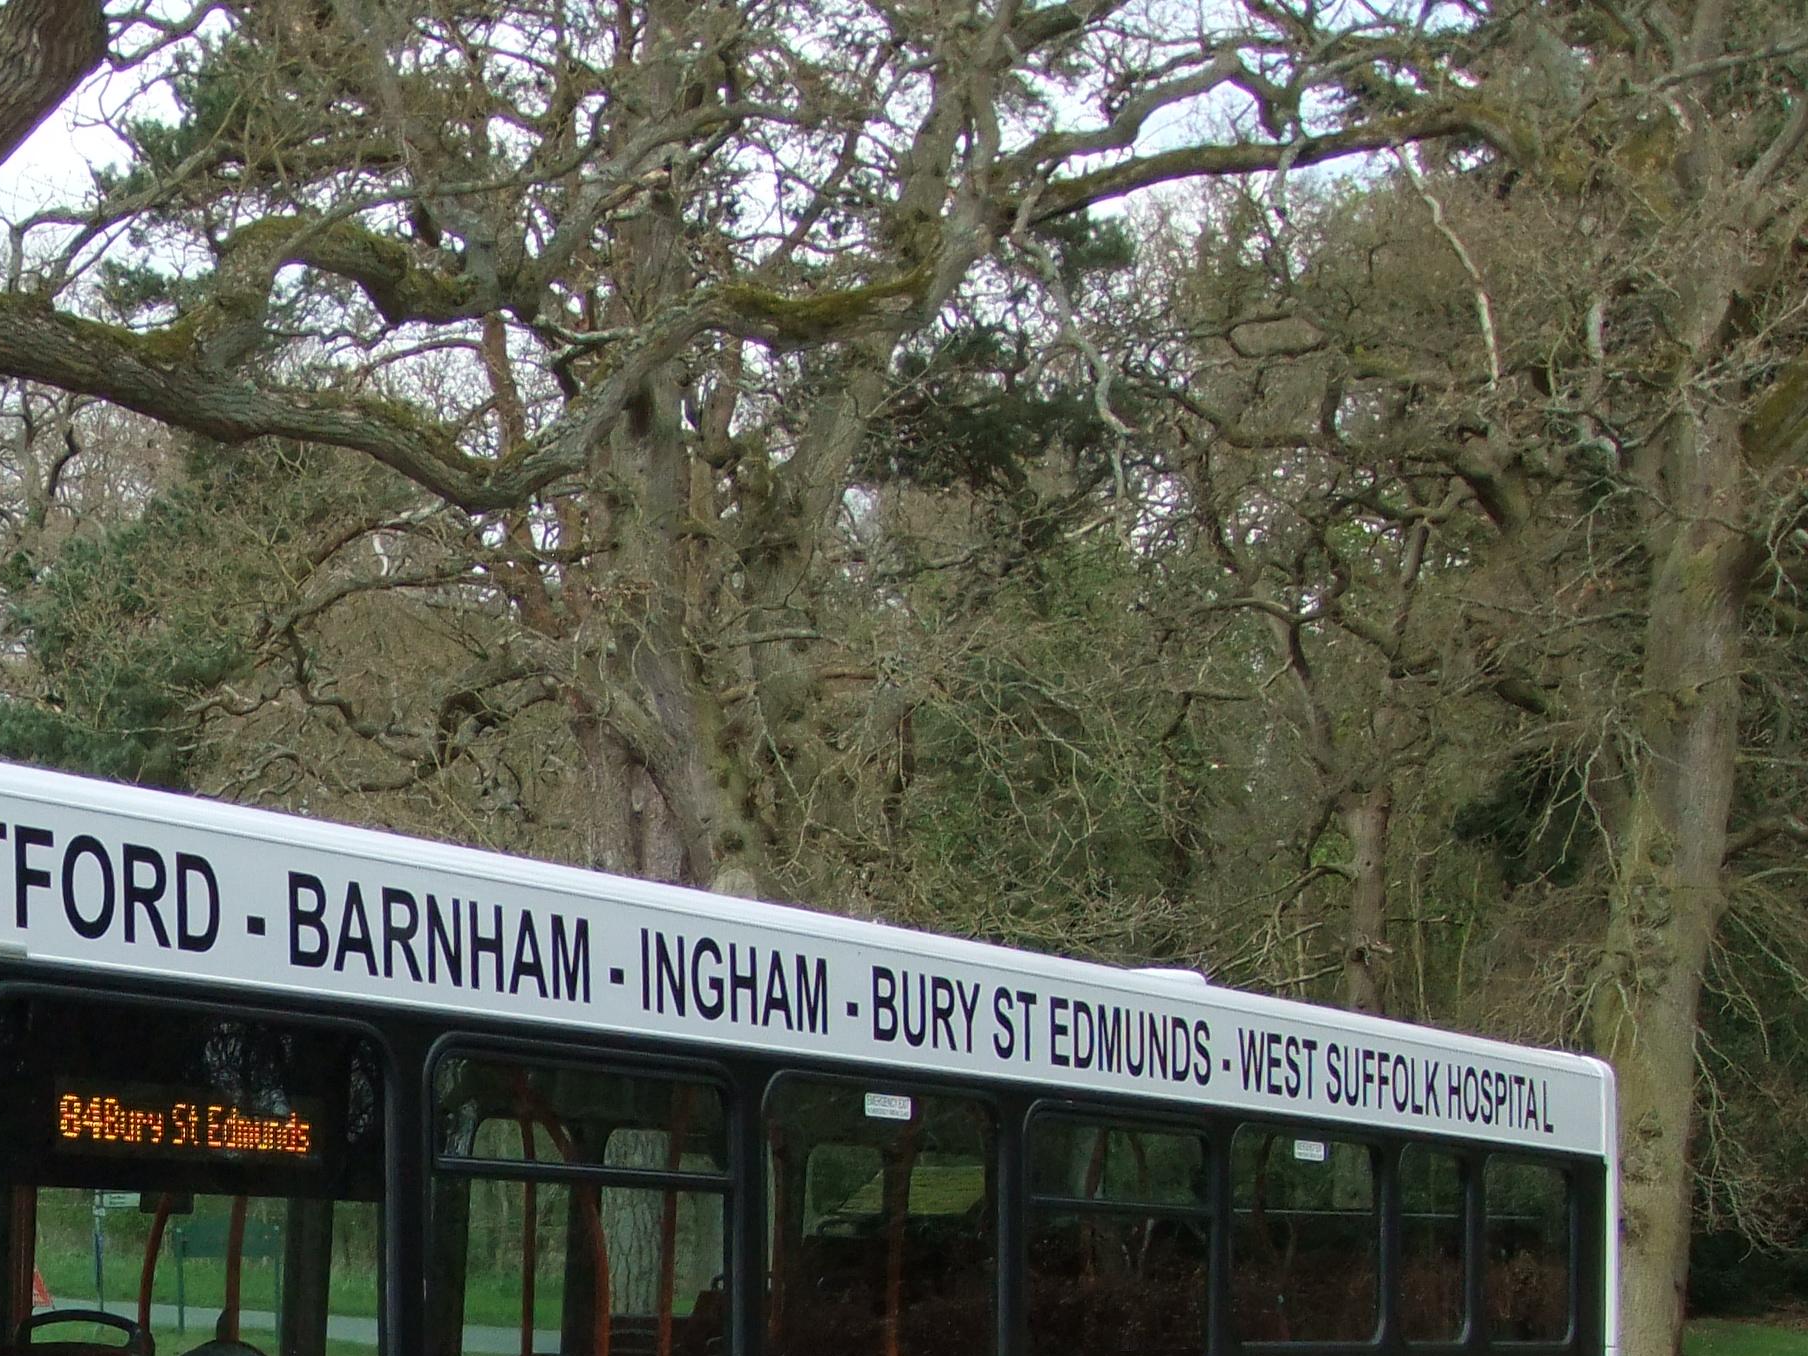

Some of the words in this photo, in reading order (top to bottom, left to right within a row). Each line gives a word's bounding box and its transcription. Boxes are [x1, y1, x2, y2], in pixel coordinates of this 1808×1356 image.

[288, 870, 592, 1004] BARNHAM
[640, 926, 829, 1036] INGHAM
[871, 965, 981, 1053] BURY
[992, 986, 1038, 1063] ST
[1049, 996, 1212, 1087] EDMUNDS
[1238, 1028, 1318, 1100] WEST
[1326, 1042, 1441, 1118] SUFFOLK
[1447, 1063, 1554, 1133] HOSPITAL
[172, 1103, 199, 1146] St
[207, 1104, 310, 1152] Edmunds
